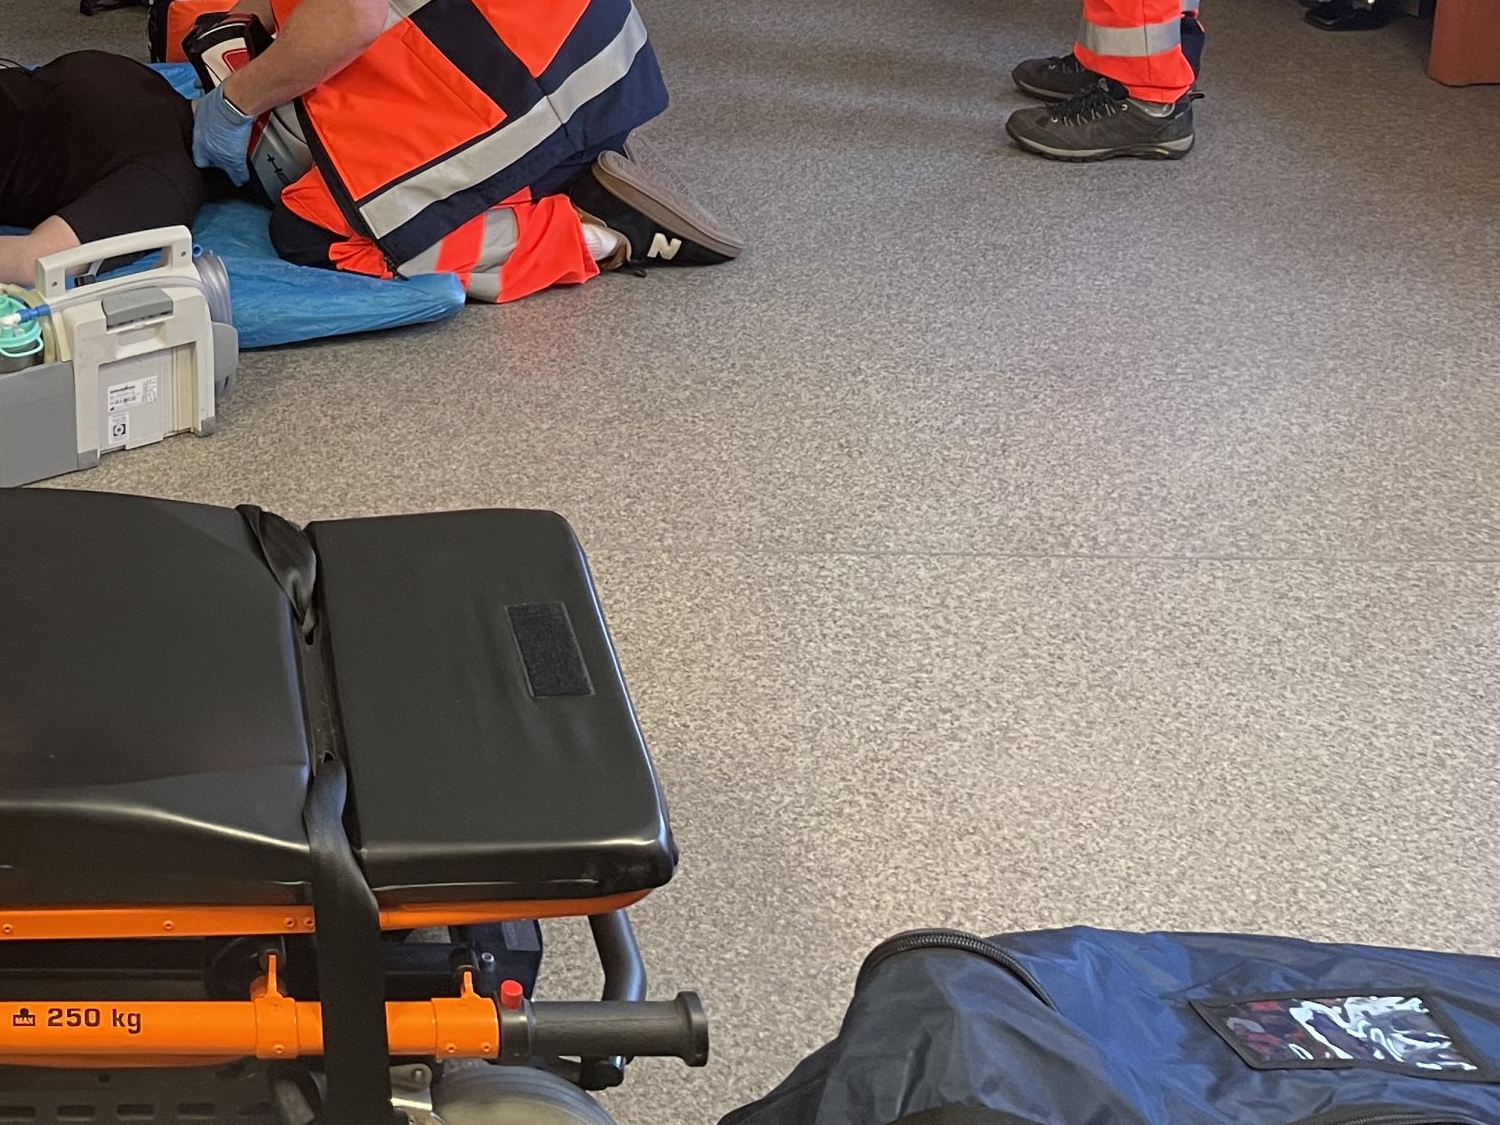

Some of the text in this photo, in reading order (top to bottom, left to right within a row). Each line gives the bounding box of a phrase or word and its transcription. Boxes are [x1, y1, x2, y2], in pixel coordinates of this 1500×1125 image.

[15, 1008, 141, 1034] MAX 250 kg
